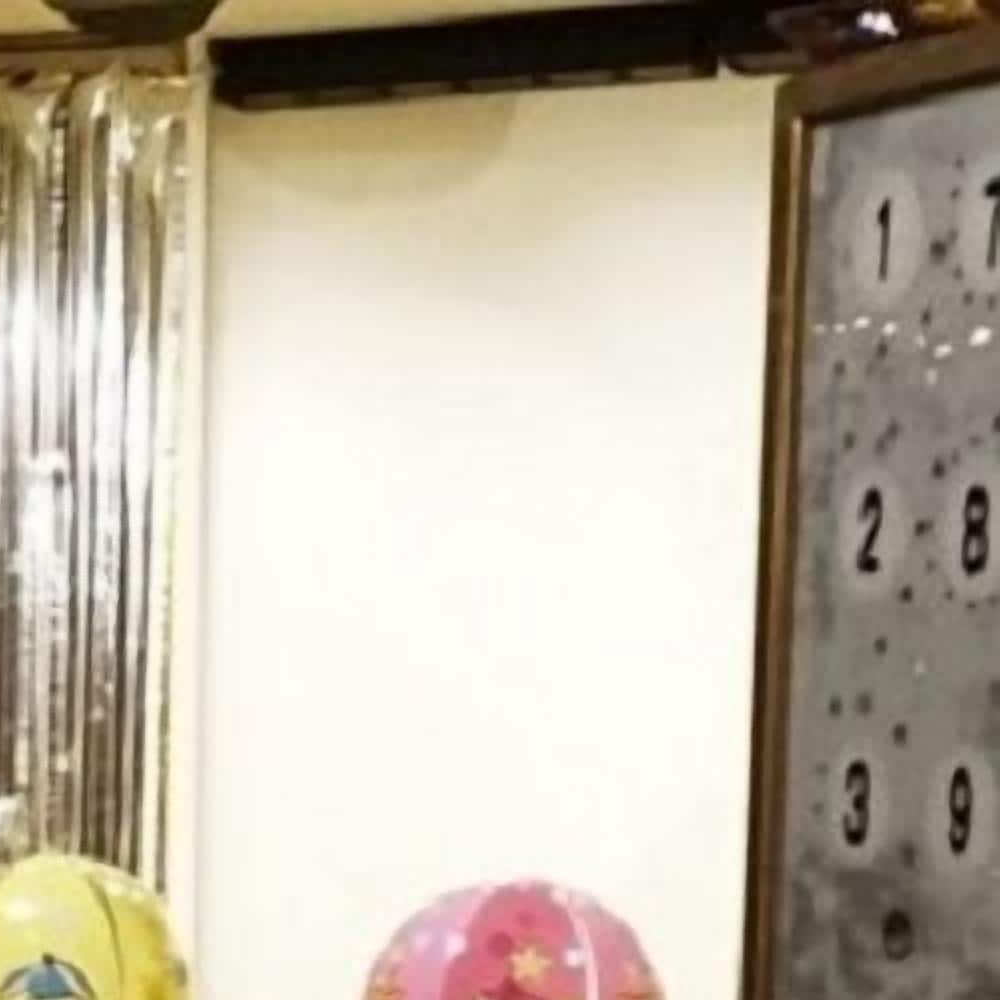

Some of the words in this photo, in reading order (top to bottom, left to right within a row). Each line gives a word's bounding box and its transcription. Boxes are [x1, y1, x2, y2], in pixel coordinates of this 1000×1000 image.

[877, 196, 891, 283] 1
[857, 485, 883, 574] 2
[961, 484, 990, 576] 8
[843, 760, 870, 846] 3
[949, 765, 972, 855] 9
